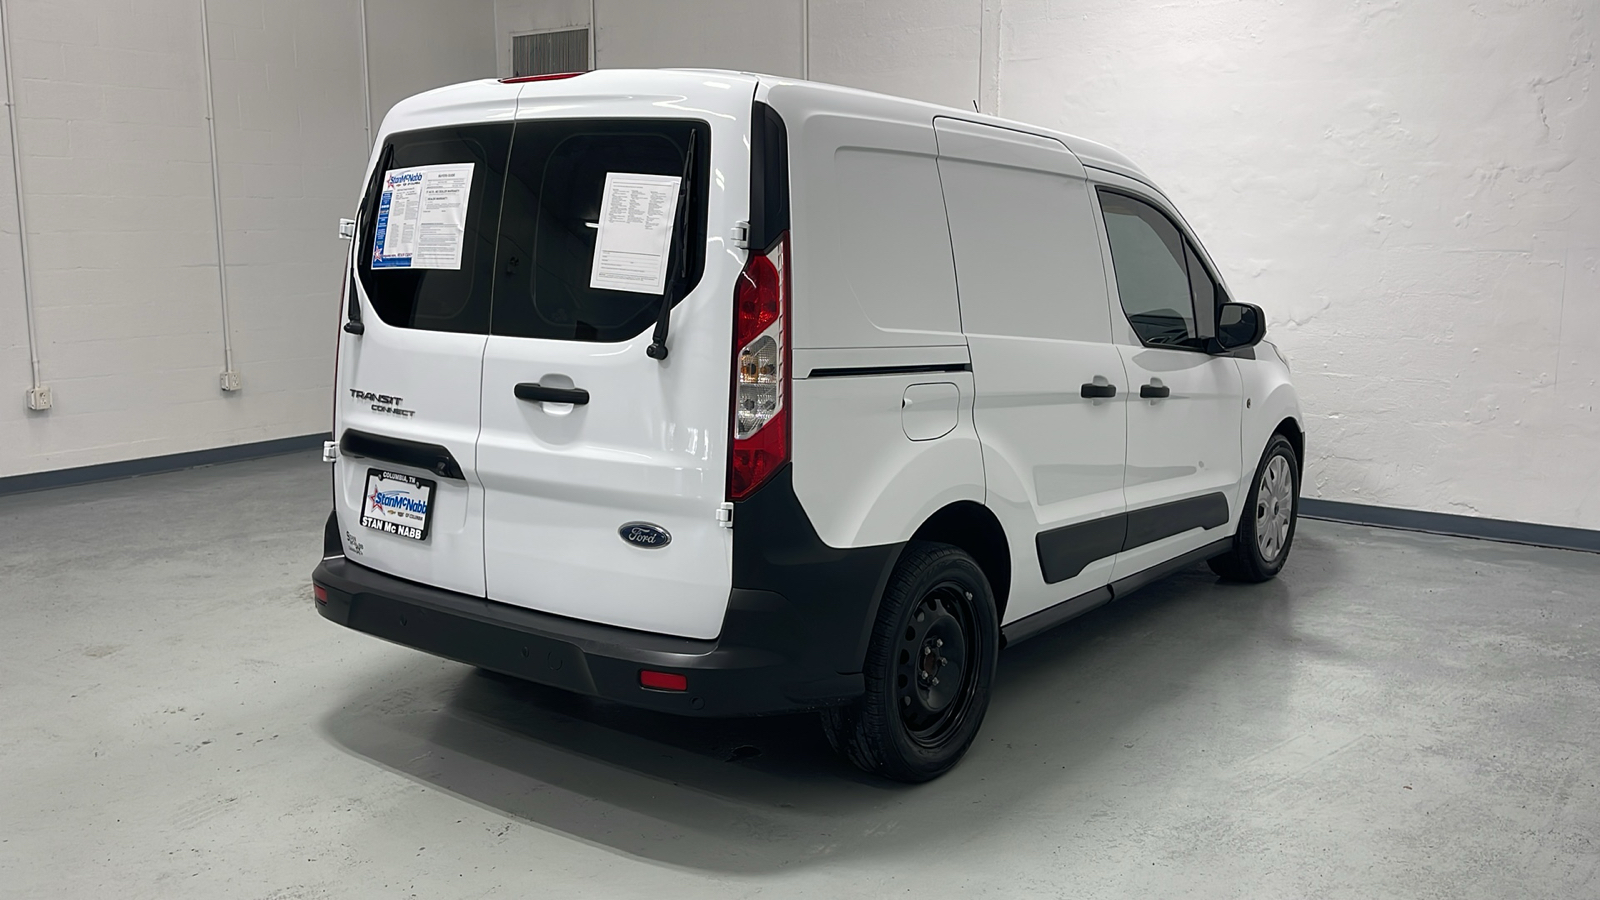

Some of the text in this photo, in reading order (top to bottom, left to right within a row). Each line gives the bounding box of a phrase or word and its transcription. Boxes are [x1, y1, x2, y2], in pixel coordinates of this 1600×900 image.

[349, 388, 403, 406] TRANSIT
[371, 404, 415, 417] CONNECT
[362, 516, 383, 530] STAN
[397, 525, 422, 540] NABB
[628, 527, 657, 544] Ford
